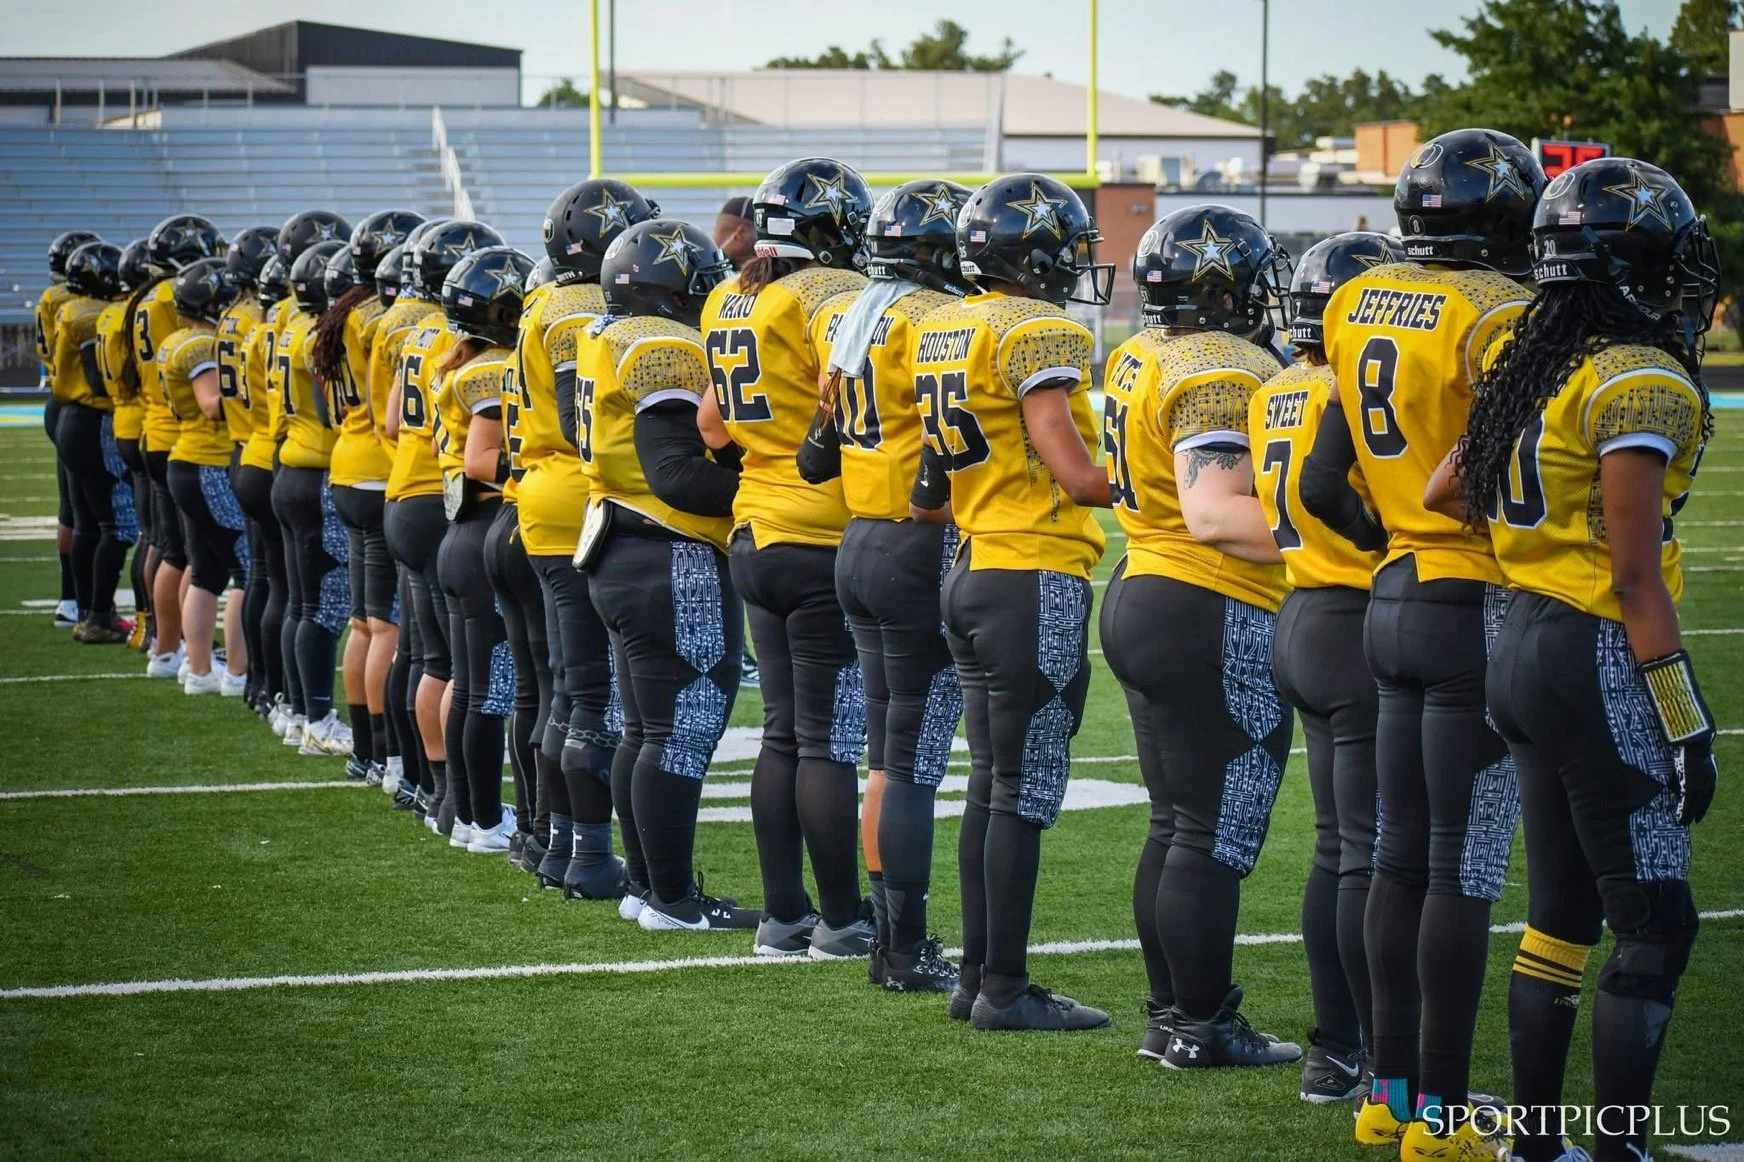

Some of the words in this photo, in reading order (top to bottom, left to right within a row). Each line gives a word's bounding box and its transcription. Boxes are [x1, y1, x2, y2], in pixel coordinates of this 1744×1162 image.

[1412, 219, 1420, 233] 8
[1407, 245, 1434, 255] schutt
[1544, 240, 1557, 255] 20
[1533, 263, 1568, 280] schutt
[1347, 288, 1448, 332] JEFFRIES
[916, 327, 977, 364] HOUSTON
[706, 328, 773, 422] 62
[1265, 390, 1309, 432] SWEET
[1357, 336, 1408, 459] 8
[914, 369, 991, 474] 35
[1262, 438, 1303, 552] 7
